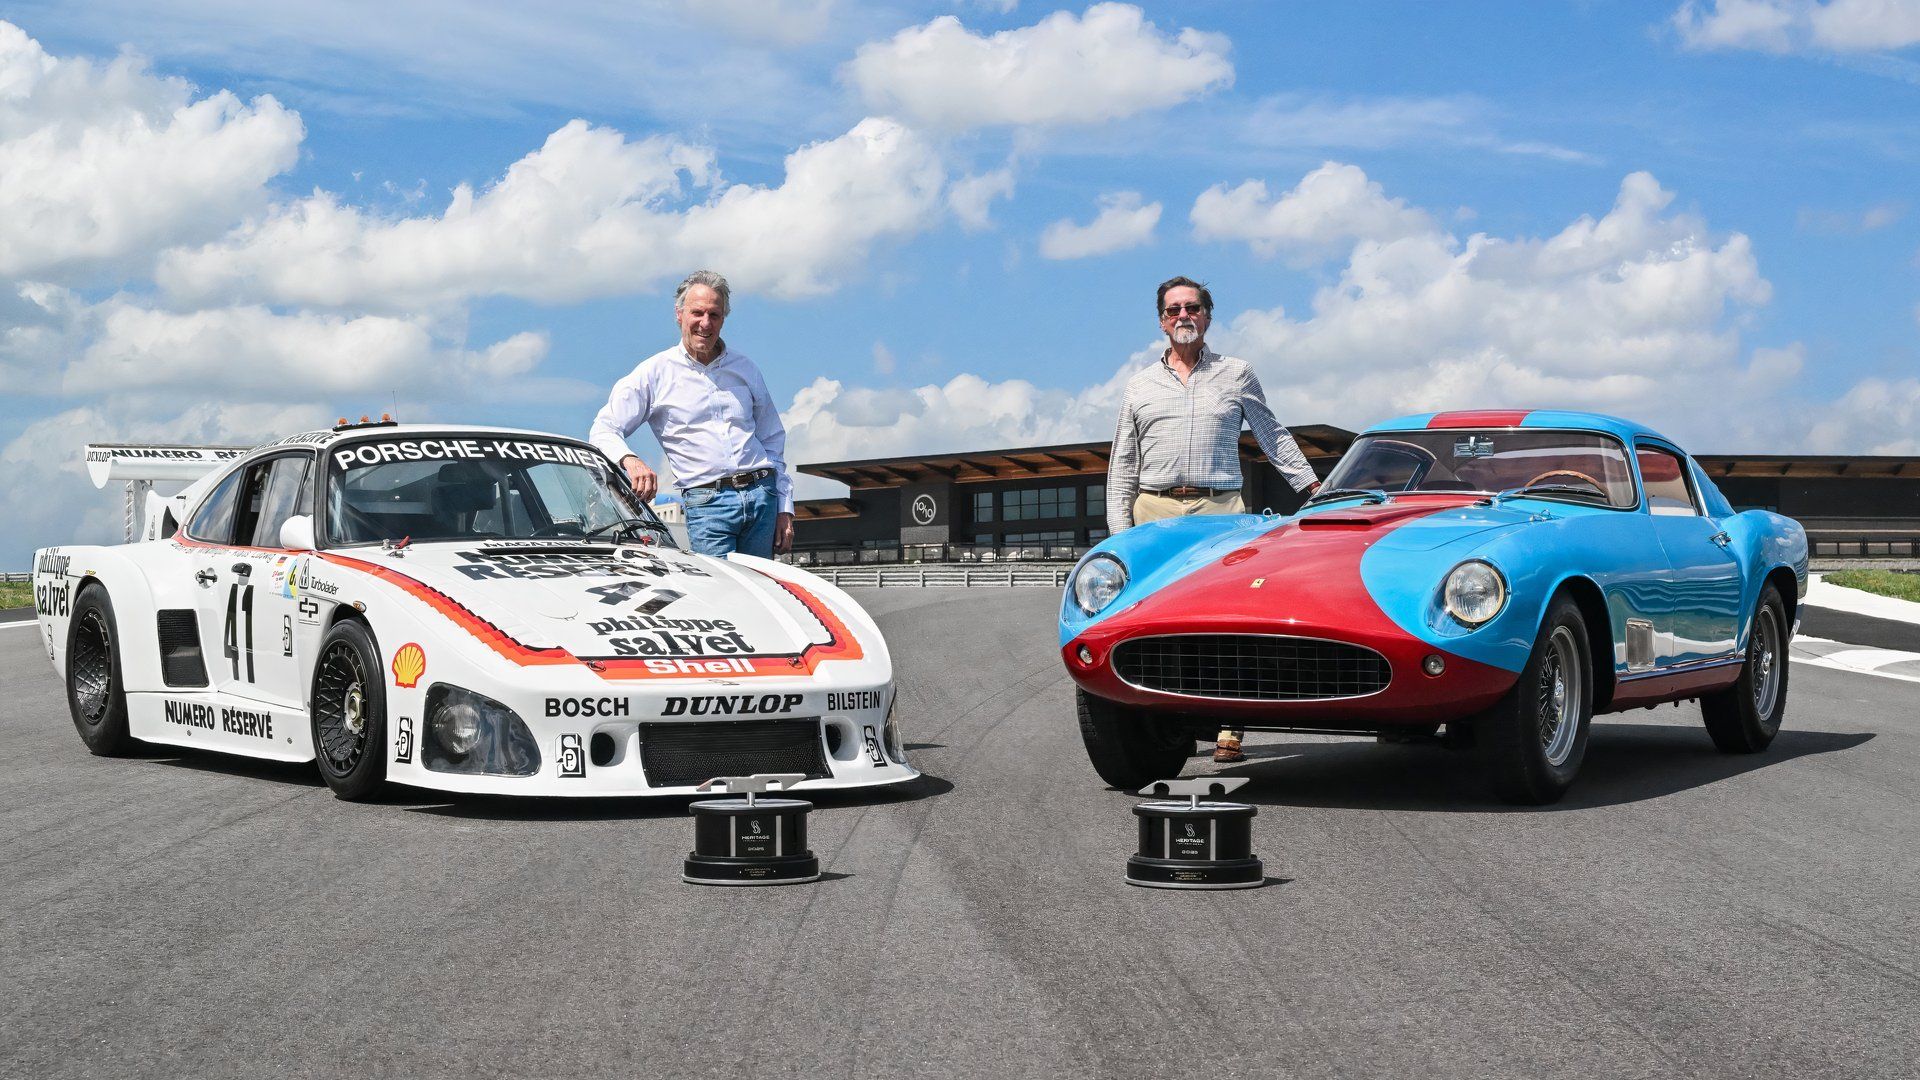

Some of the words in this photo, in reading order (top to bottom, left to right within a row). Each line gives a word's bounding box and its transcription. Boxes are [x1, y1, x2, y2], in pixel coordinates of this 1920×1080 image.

[111, 449, 203, 459] NUMERO
[334, 440, 614, 474] PORSCHE-KREMER
[37, 547, 71, 580] philippe
[37, 580, 70, 617] salvet
[585, 580, 687, 616] 41
[223, 583, 255, 684] 41
[586, 615, 736, 636] philippe
[608, 630, 756, 656] salvet
[643, 658, 756, 675] Shell
[545, 697, 630, 718] BOSCH
[660, 693, 804, 717] DUNLOP
[827, 691, 881, 711] BILSTEIN
[164, 699, 216, 731] NUMERO
[221, 705, 274, 740] RÉSERVÉ
